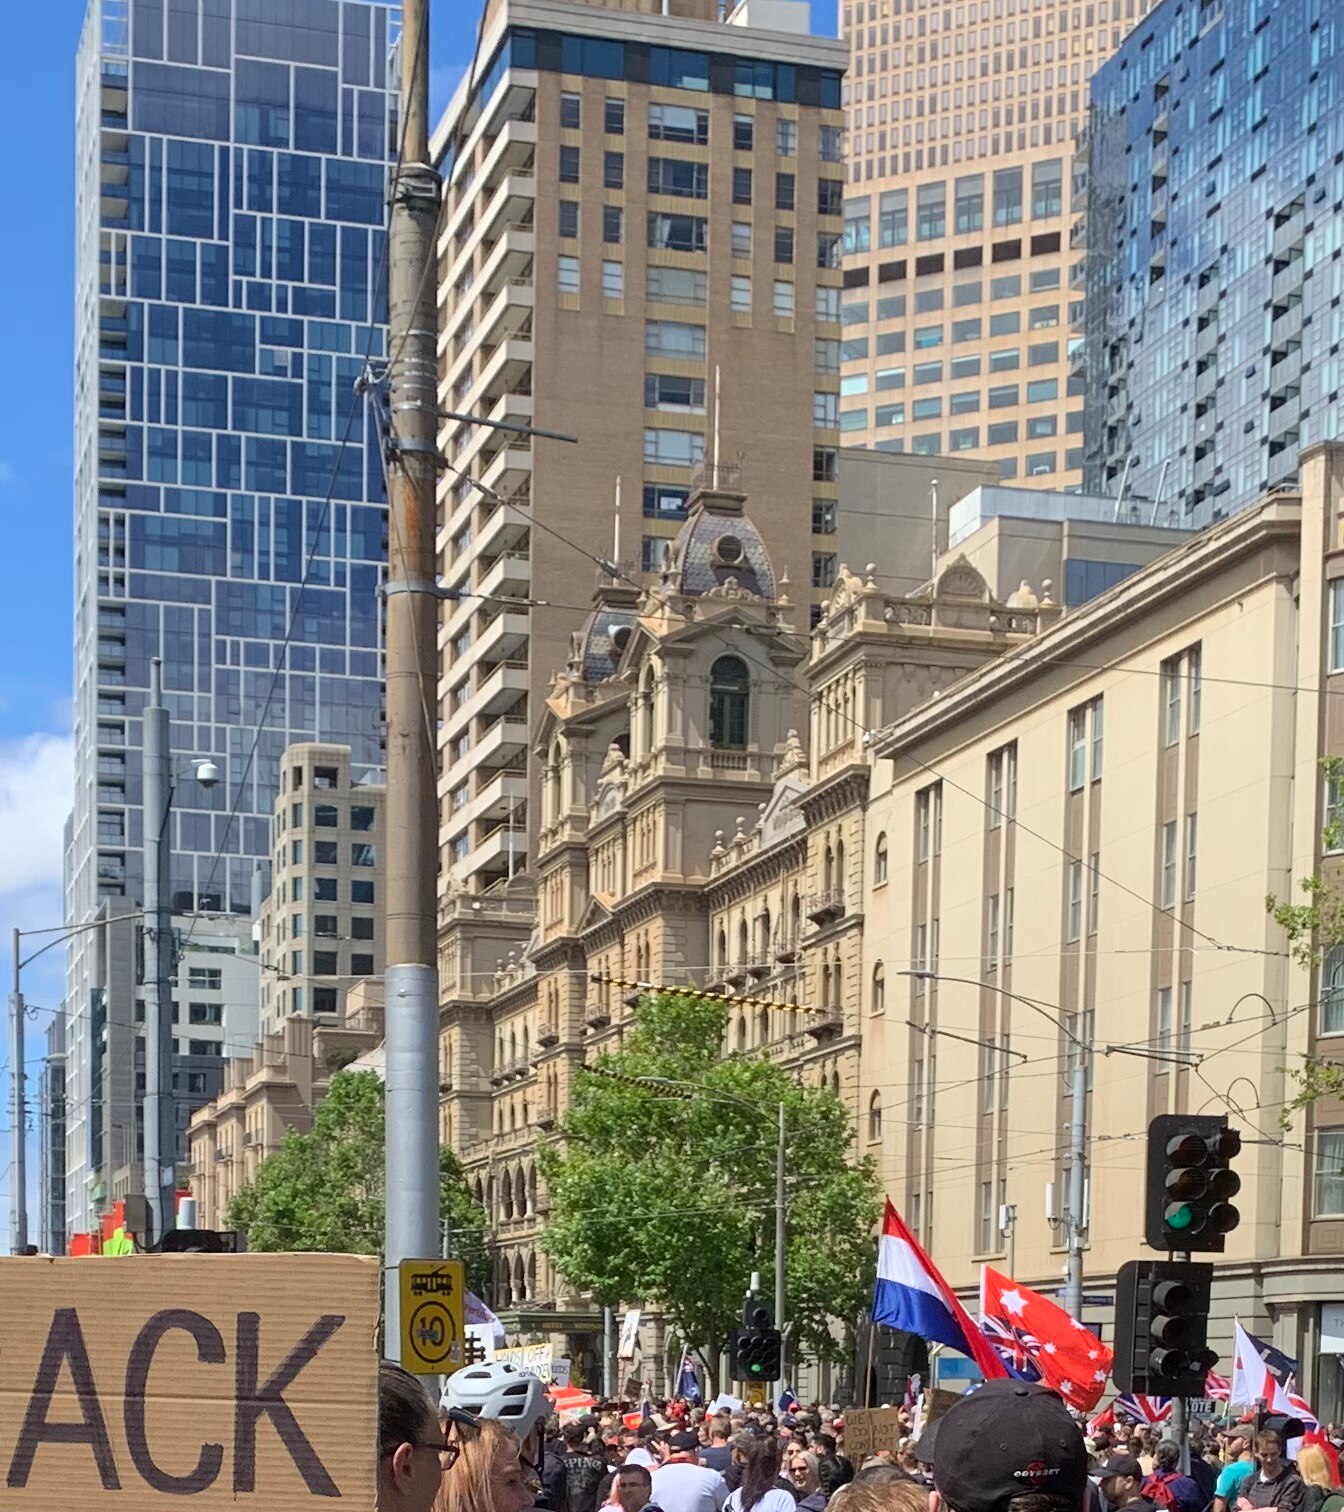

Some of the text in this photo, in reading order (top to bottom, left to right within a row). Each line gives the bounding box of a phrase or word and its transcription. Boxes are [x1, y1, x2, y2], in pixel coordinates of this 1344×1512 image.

[419, 1316, 444, 1347] 10
[1191, 1402, 1212, 1413] OTE
[846, 1414, 865, 1426] WE
[873, 1424, 895, 1435] NOT
[849, 1436, 894, 1451] CONENT
